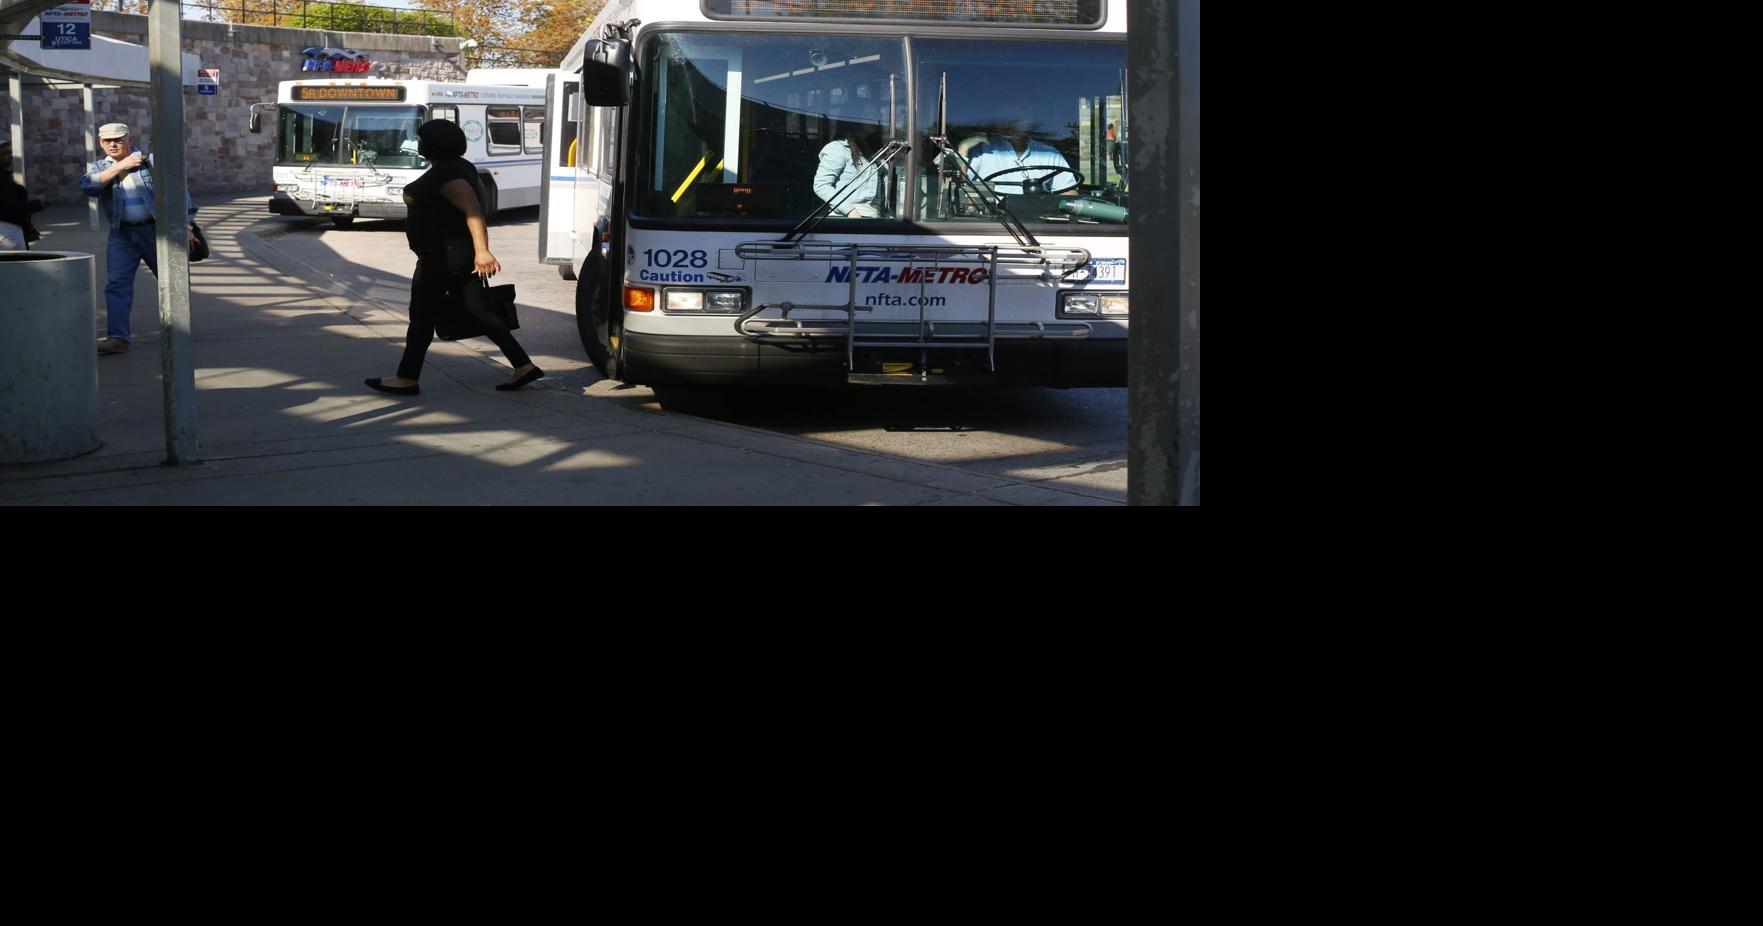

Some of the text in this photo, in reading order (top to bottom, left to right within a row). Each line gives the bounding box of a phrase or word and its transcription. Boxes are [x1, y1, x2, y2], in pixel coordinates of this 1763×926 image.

[57, 23, 76, 35] 12
[319, 88, 395, 99] DOWNTOWN
[643, 249, 708, 269] 1028
[640, 269, 704, 282] Caution
[824, 266, 990, 285] NFTA-METRO
[865, 293, 946, 306] nfta.com
